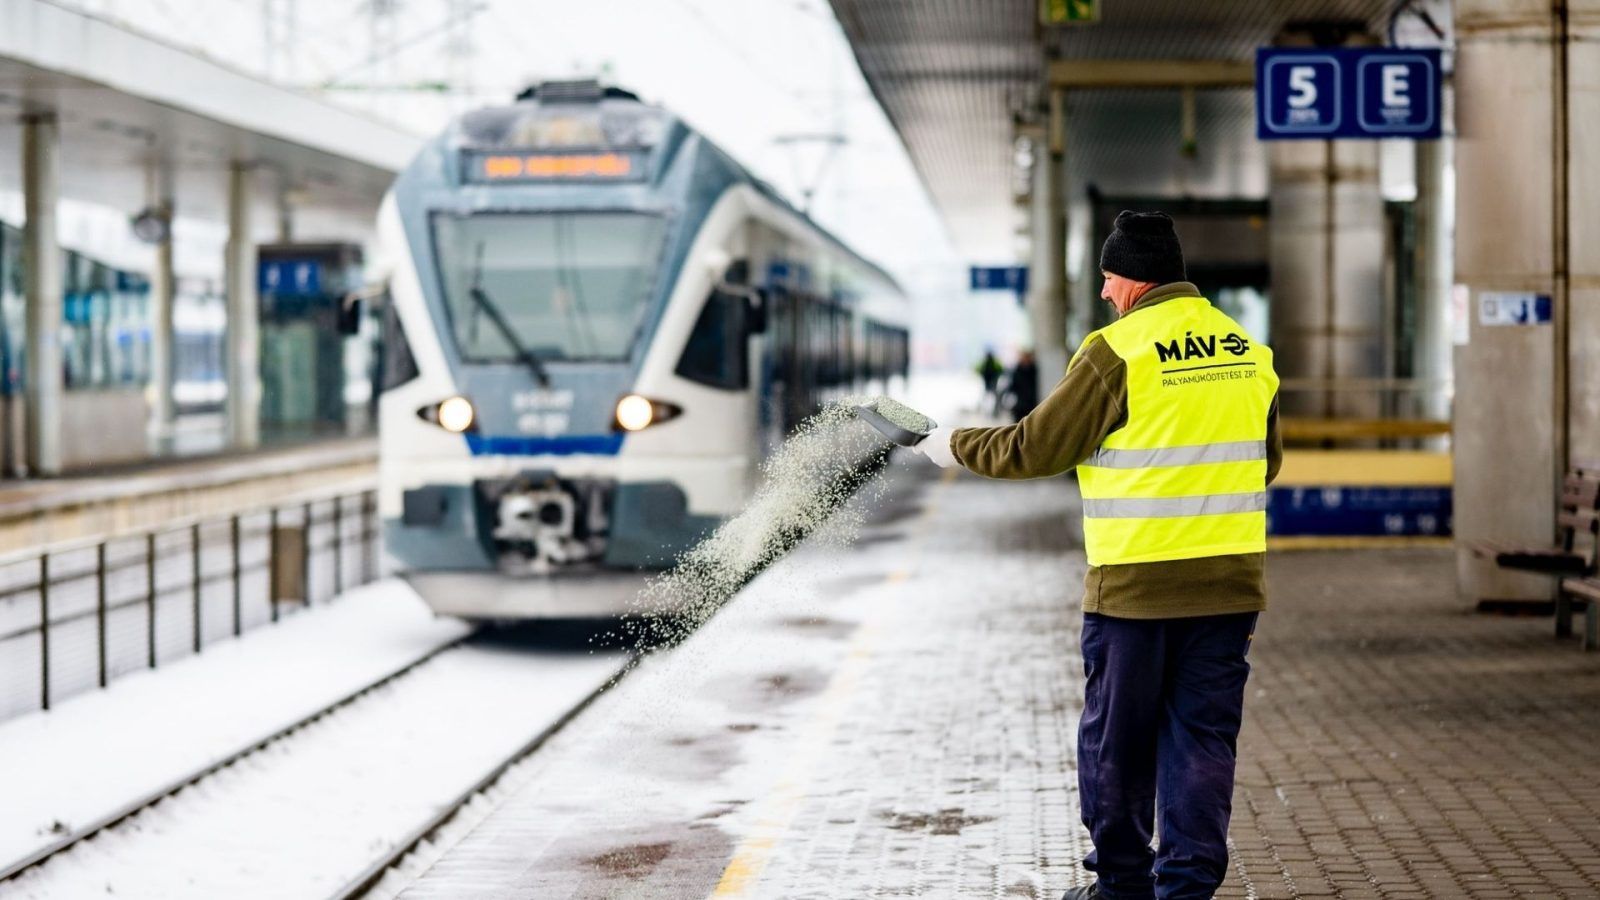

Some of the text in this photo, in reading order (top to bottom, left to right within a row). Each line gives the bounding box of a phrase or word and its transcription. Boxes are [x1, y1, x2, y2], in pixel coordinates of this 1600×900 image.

[1288, 64, 1411, 107] 5 E
[1154, 331, 1216, 362] MÁV
